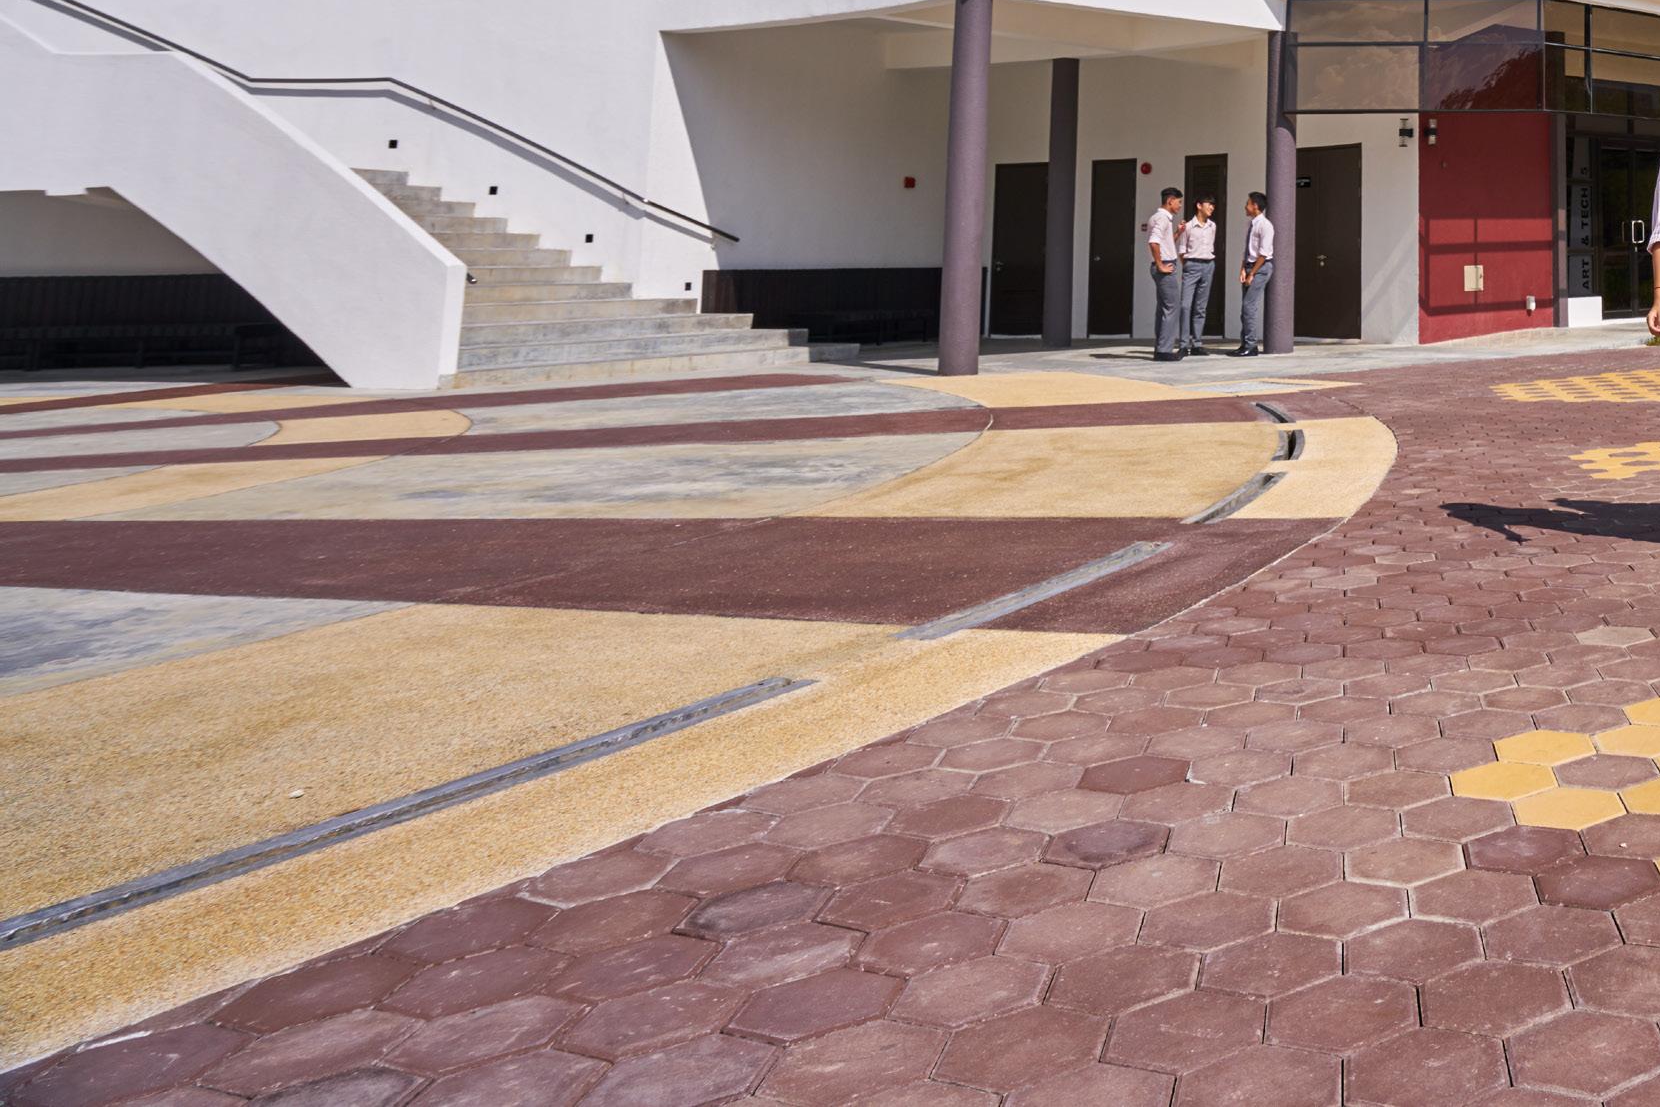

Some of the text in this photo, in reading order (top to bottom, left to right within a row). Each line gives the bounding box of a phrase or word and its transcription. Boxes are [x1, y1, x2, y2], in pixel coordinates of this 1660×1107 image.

[1581, 187, 1589, 229] TECH
[1581, 235, 1589, 246] &
[1581, 258, 1590, 290] ART
